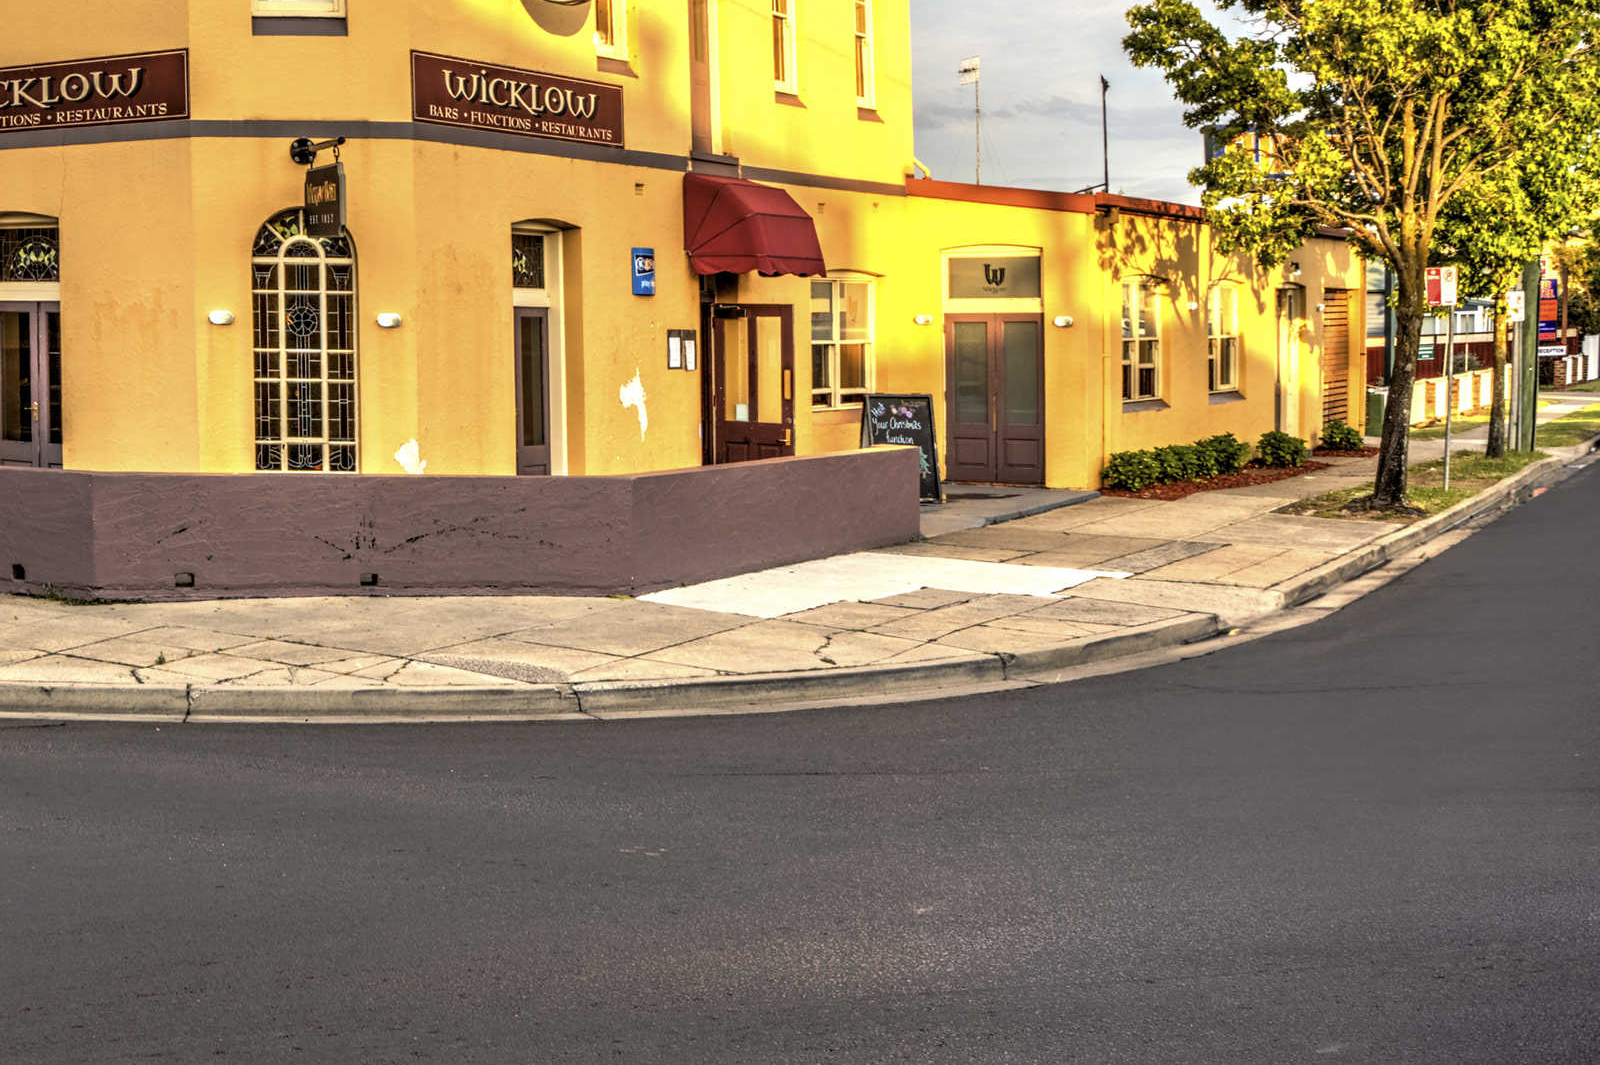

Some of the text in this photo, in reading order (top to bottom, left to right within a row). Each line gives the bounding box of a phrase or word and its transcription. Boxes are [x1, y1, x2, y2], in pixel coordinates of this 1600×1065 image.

[55, 102, 168, 123] RESTAURANTS
[429, 104, 613, 141] BARS FUNCTIONS RESTAURANTS
